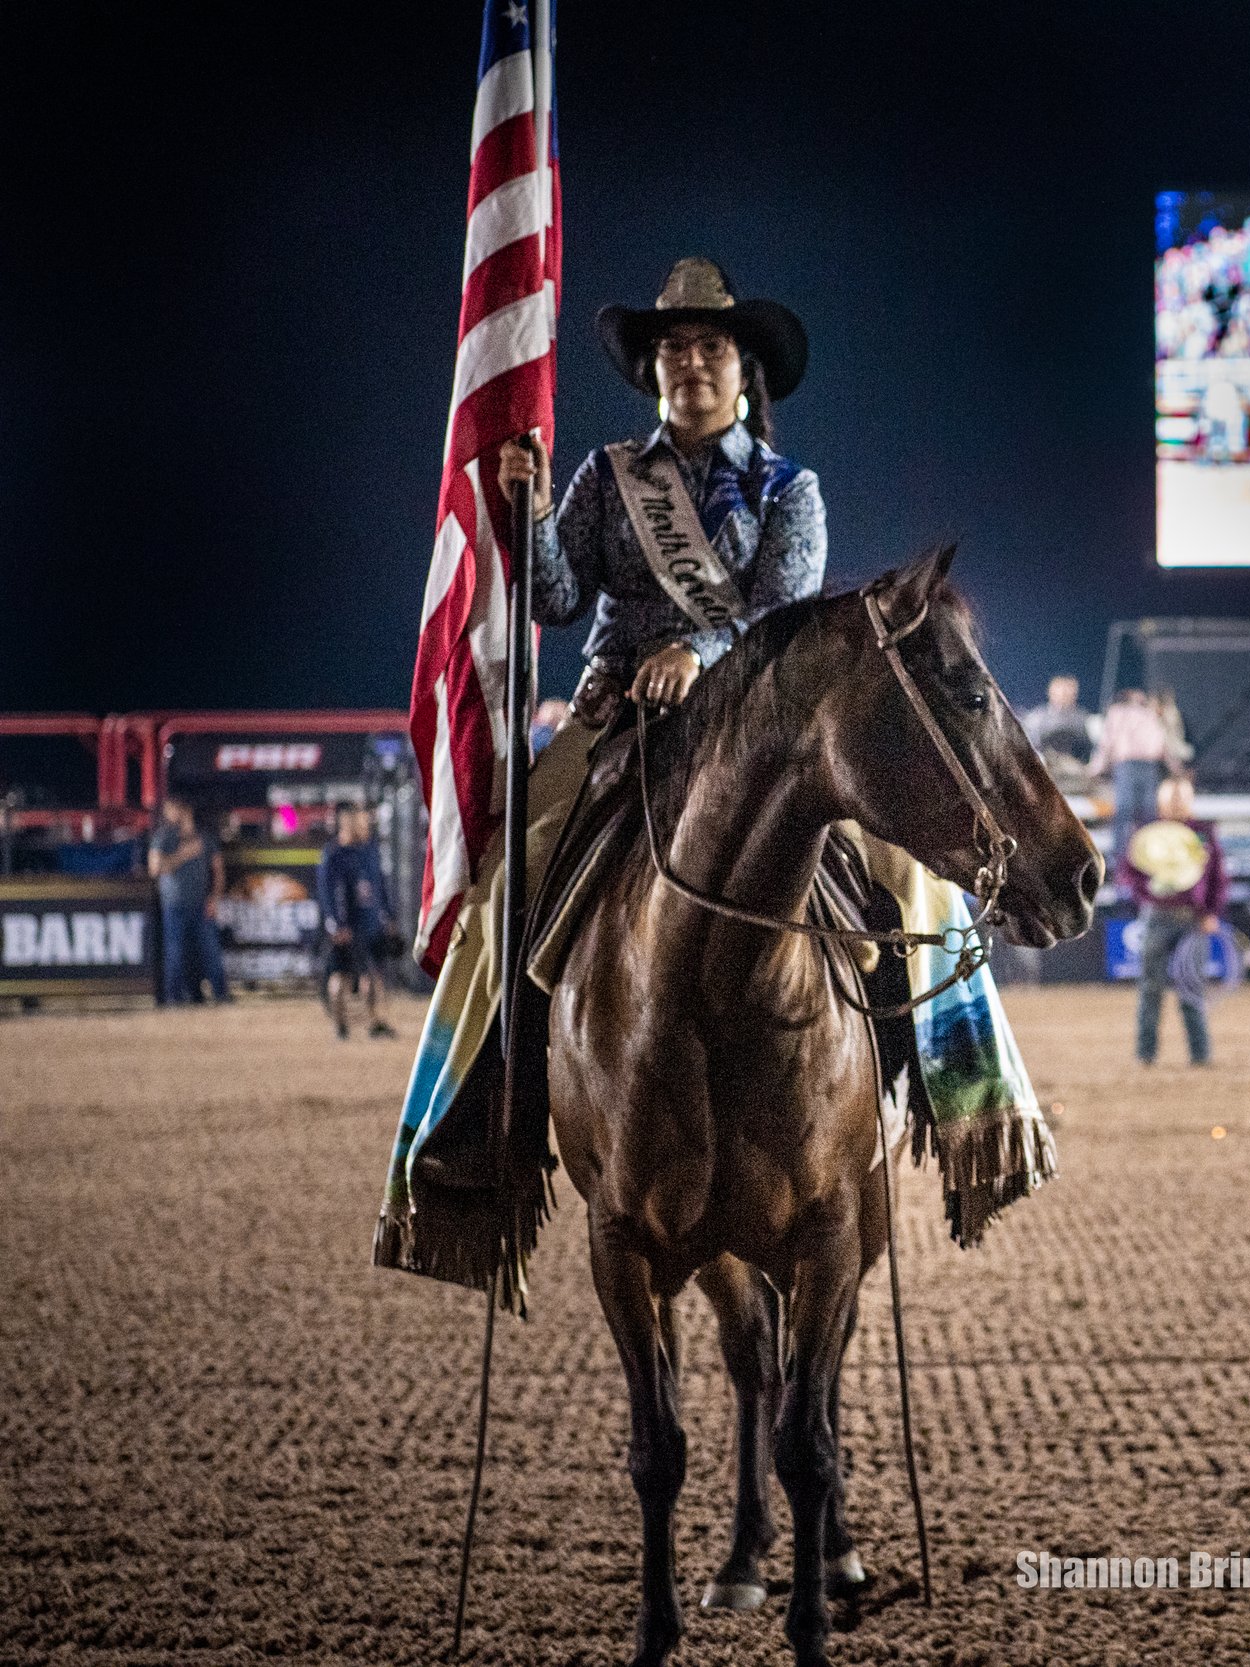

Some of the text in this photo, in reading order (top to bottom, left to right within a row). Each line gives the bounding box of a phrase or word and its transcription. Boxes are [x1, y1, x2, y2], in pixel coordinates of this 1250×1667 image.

[641, 497, 730, 625] North Caroli
[2, 912, 144, 966] BARN
